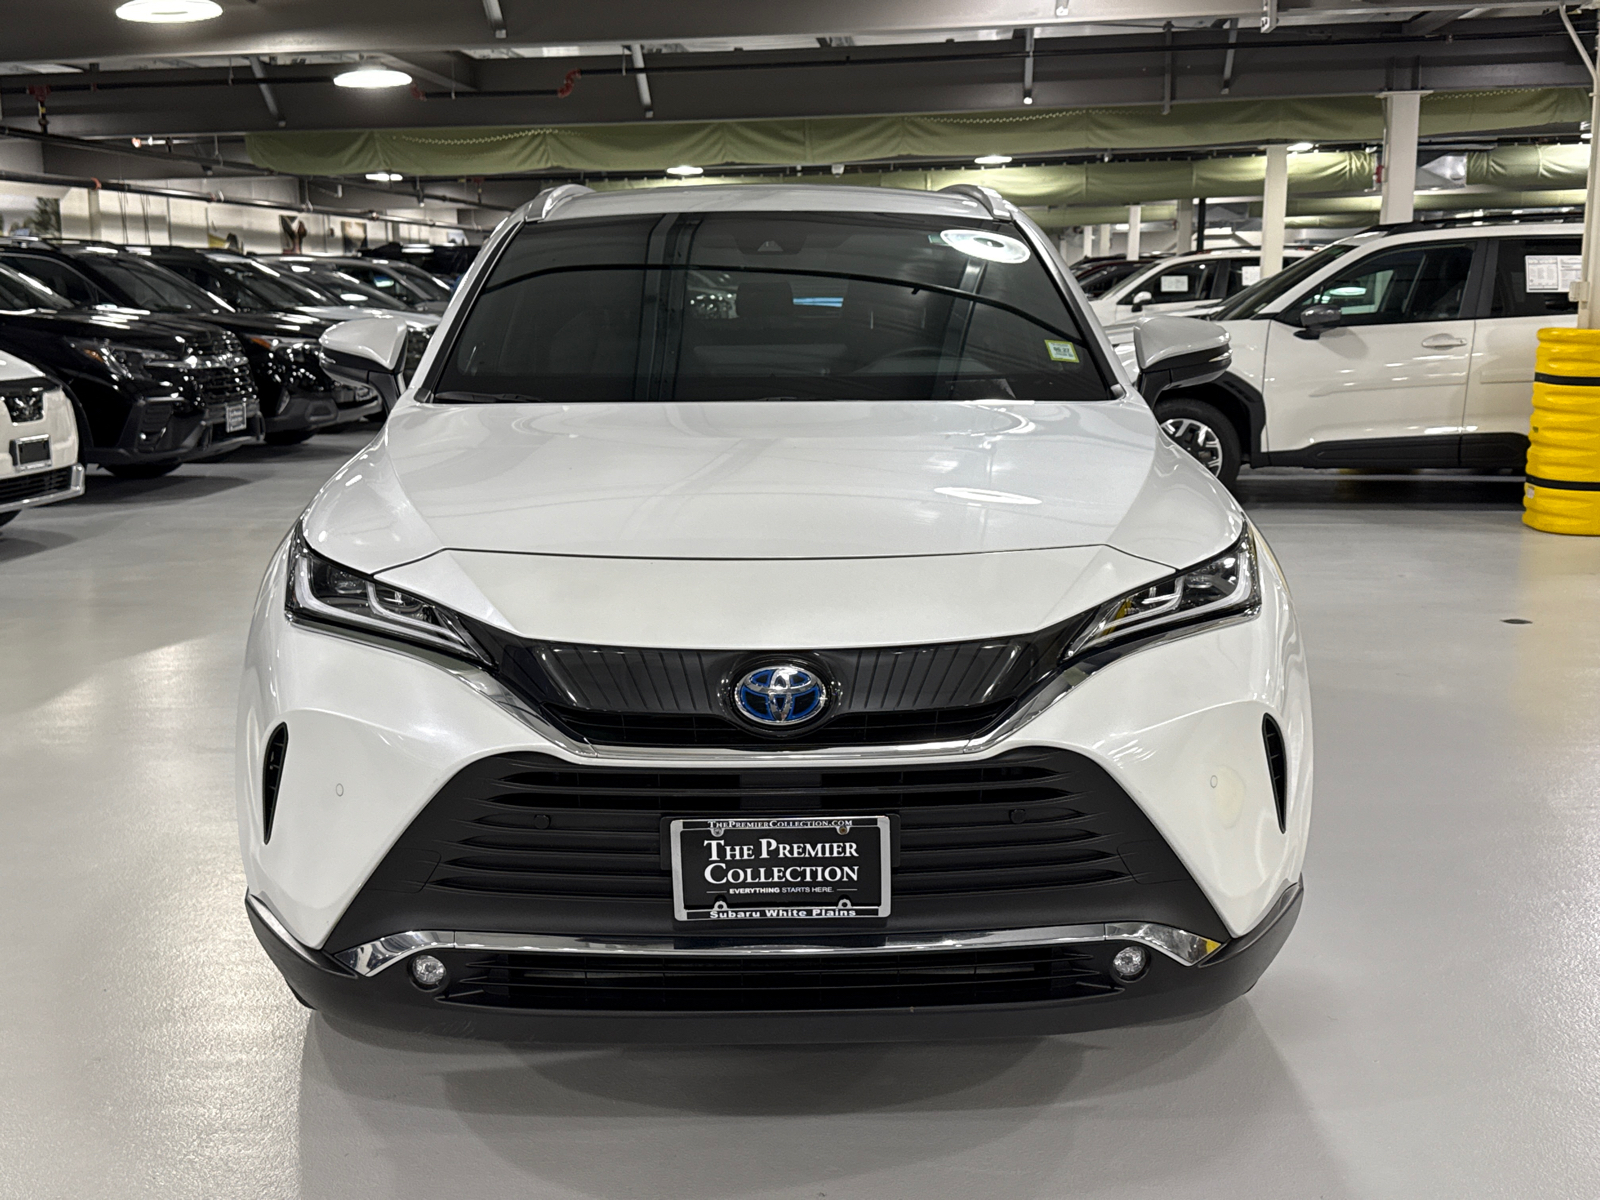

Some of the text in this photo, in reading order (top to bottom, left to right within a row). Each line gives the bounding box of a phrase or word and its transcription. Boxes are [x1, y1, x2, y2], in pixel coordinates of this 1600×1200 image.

[703, 838, 859, 861] THE PREMIER
[704, 862, 859, 884] COLLECTION
[709, 908, 856, 918] Subaru White Plains
